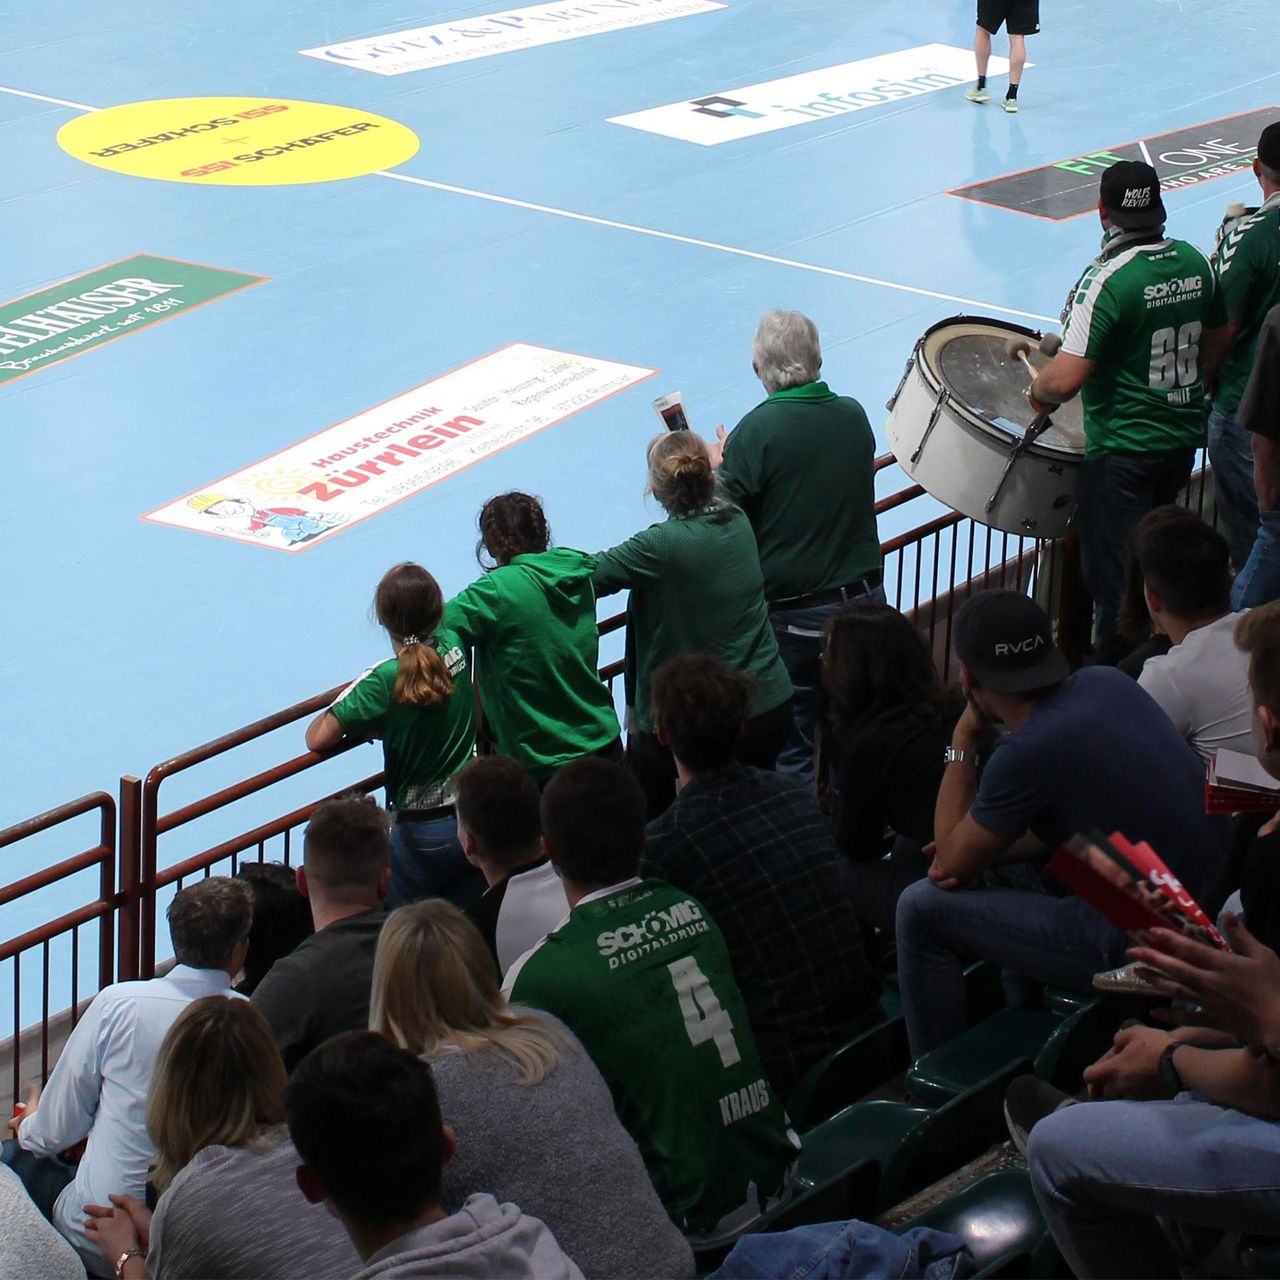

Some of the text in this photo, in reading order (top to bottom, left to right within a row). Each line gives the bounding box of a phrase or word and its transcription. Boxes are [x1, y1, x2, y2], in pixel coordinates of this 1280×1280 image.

[770, 70, 964, 119] infosim
[233, 121, 381, 164] SCHÄFER
[1158, 137, 1258, 167] ONE
[1143, 275, 1203, 301] SCHÖMIG
[1146, 290, 1203, 309] DIGITALDRUCK
[296, 412, 487, 503] zürrlein
[310, 402, 444, 479] Haustechnik
[995, 634, 1045, 657] RVCA
[595, 899, 702, 959] SCHÖMIG
[607, 919, 710, 971] DIGITALDRUCK
[666, 954, 742, 1069] 4
[718, 1078, 770, 1127] KRAUS
